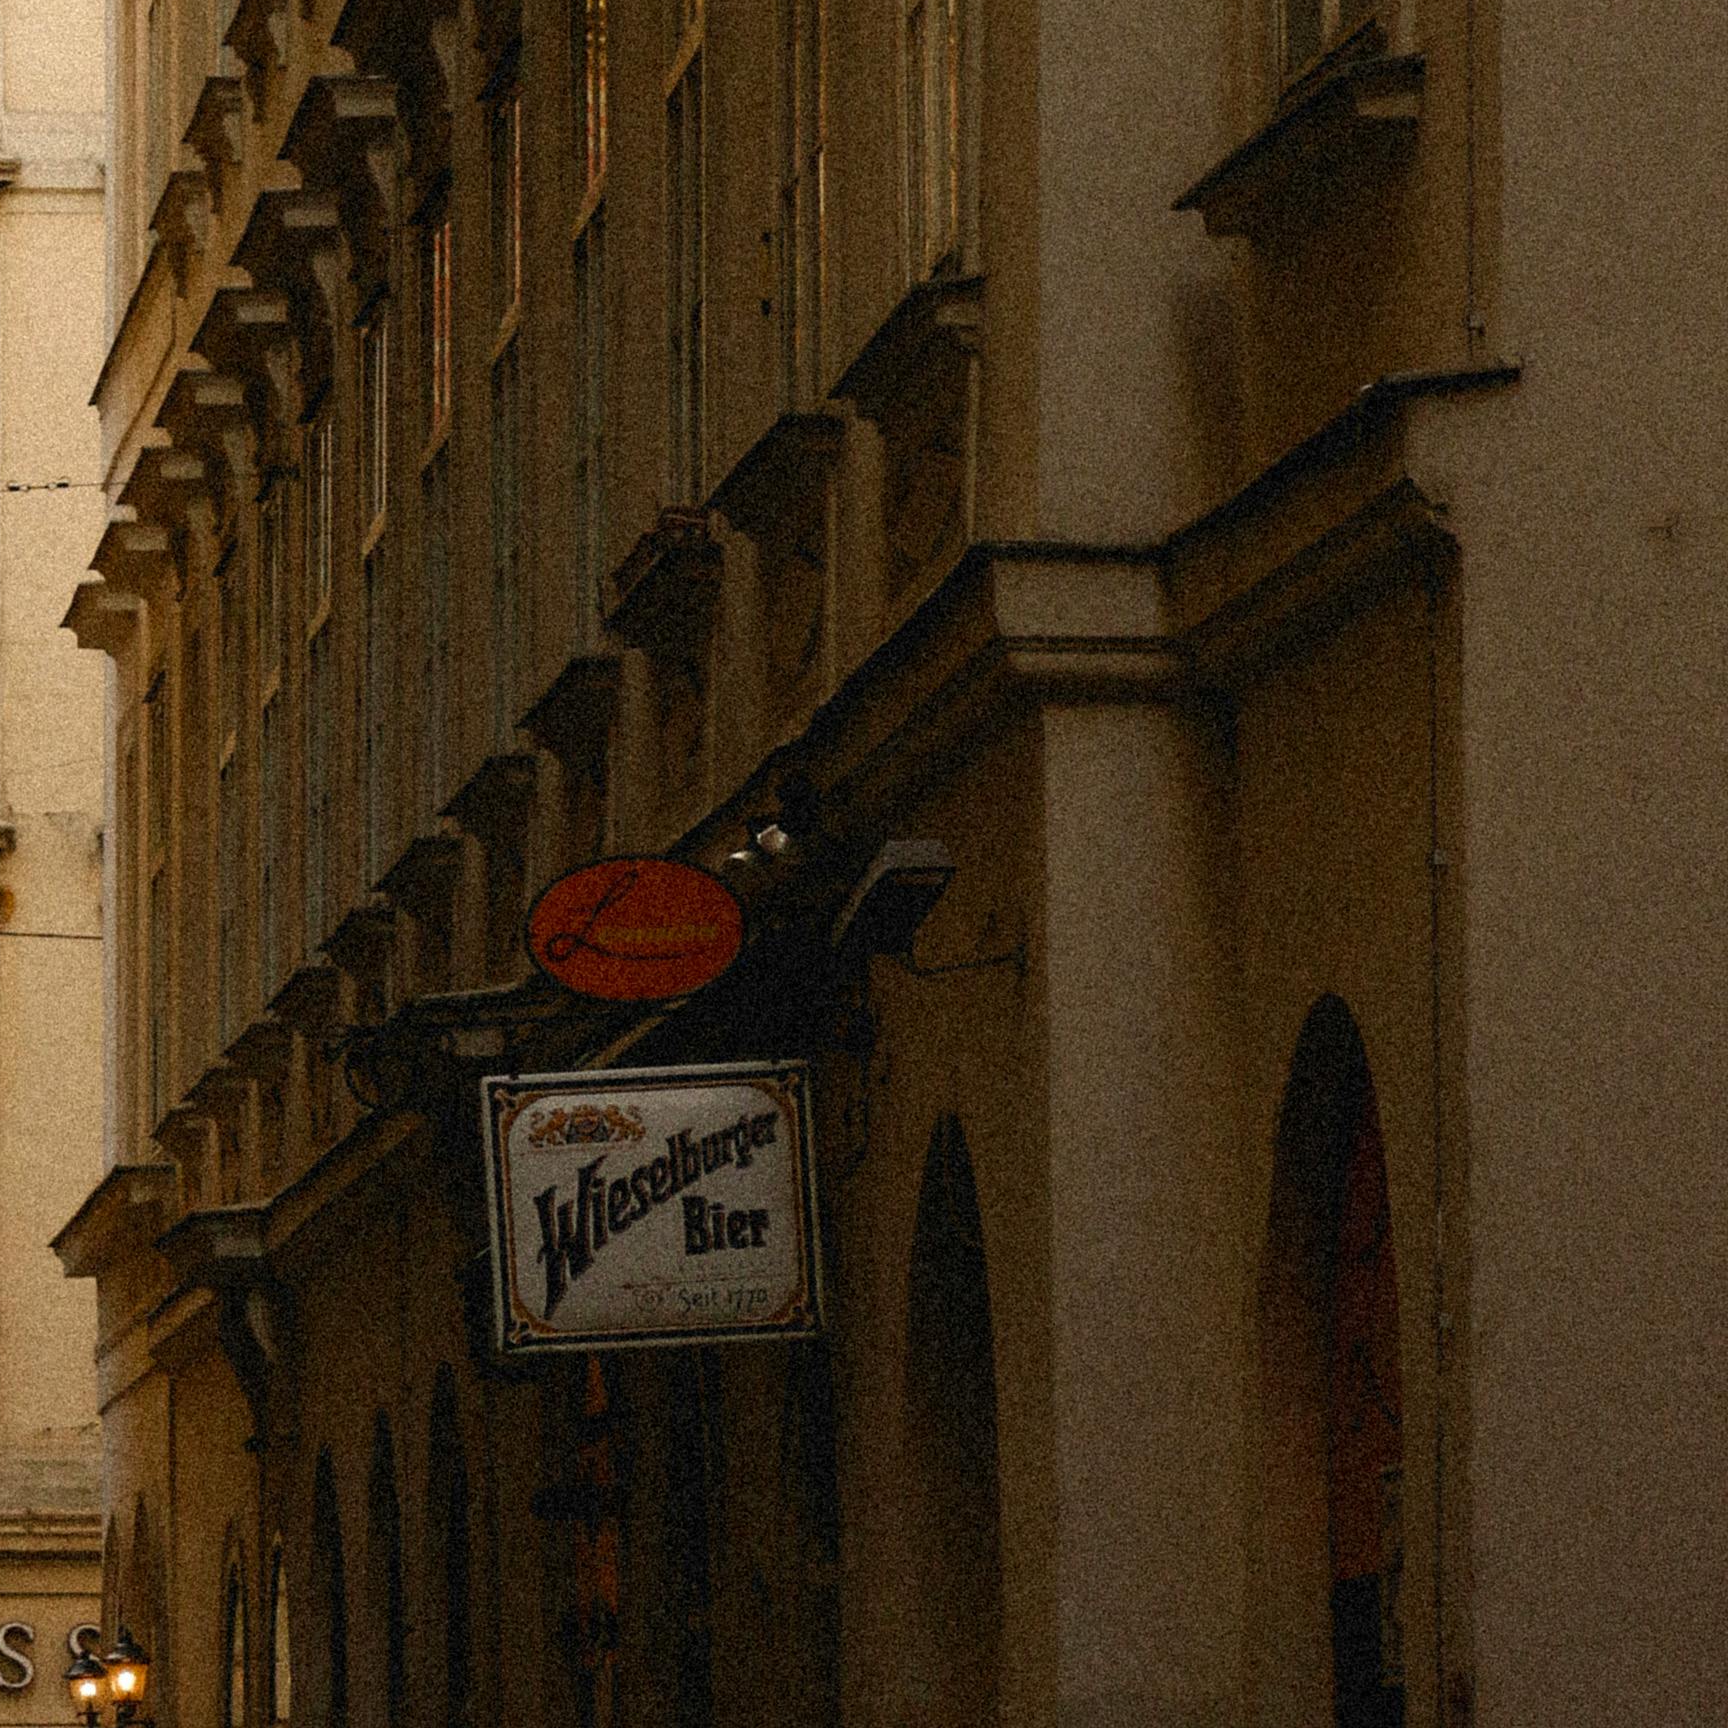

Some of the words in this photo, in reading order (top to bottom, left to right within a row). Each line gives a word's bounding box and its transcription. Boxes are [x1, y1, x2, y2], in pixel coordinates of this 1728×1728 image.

[534, 1110, 778, 1321] Wieselburger
[682, 1195, 769, 1257] Bier
[677, 1285, 719, 1315] Seit
